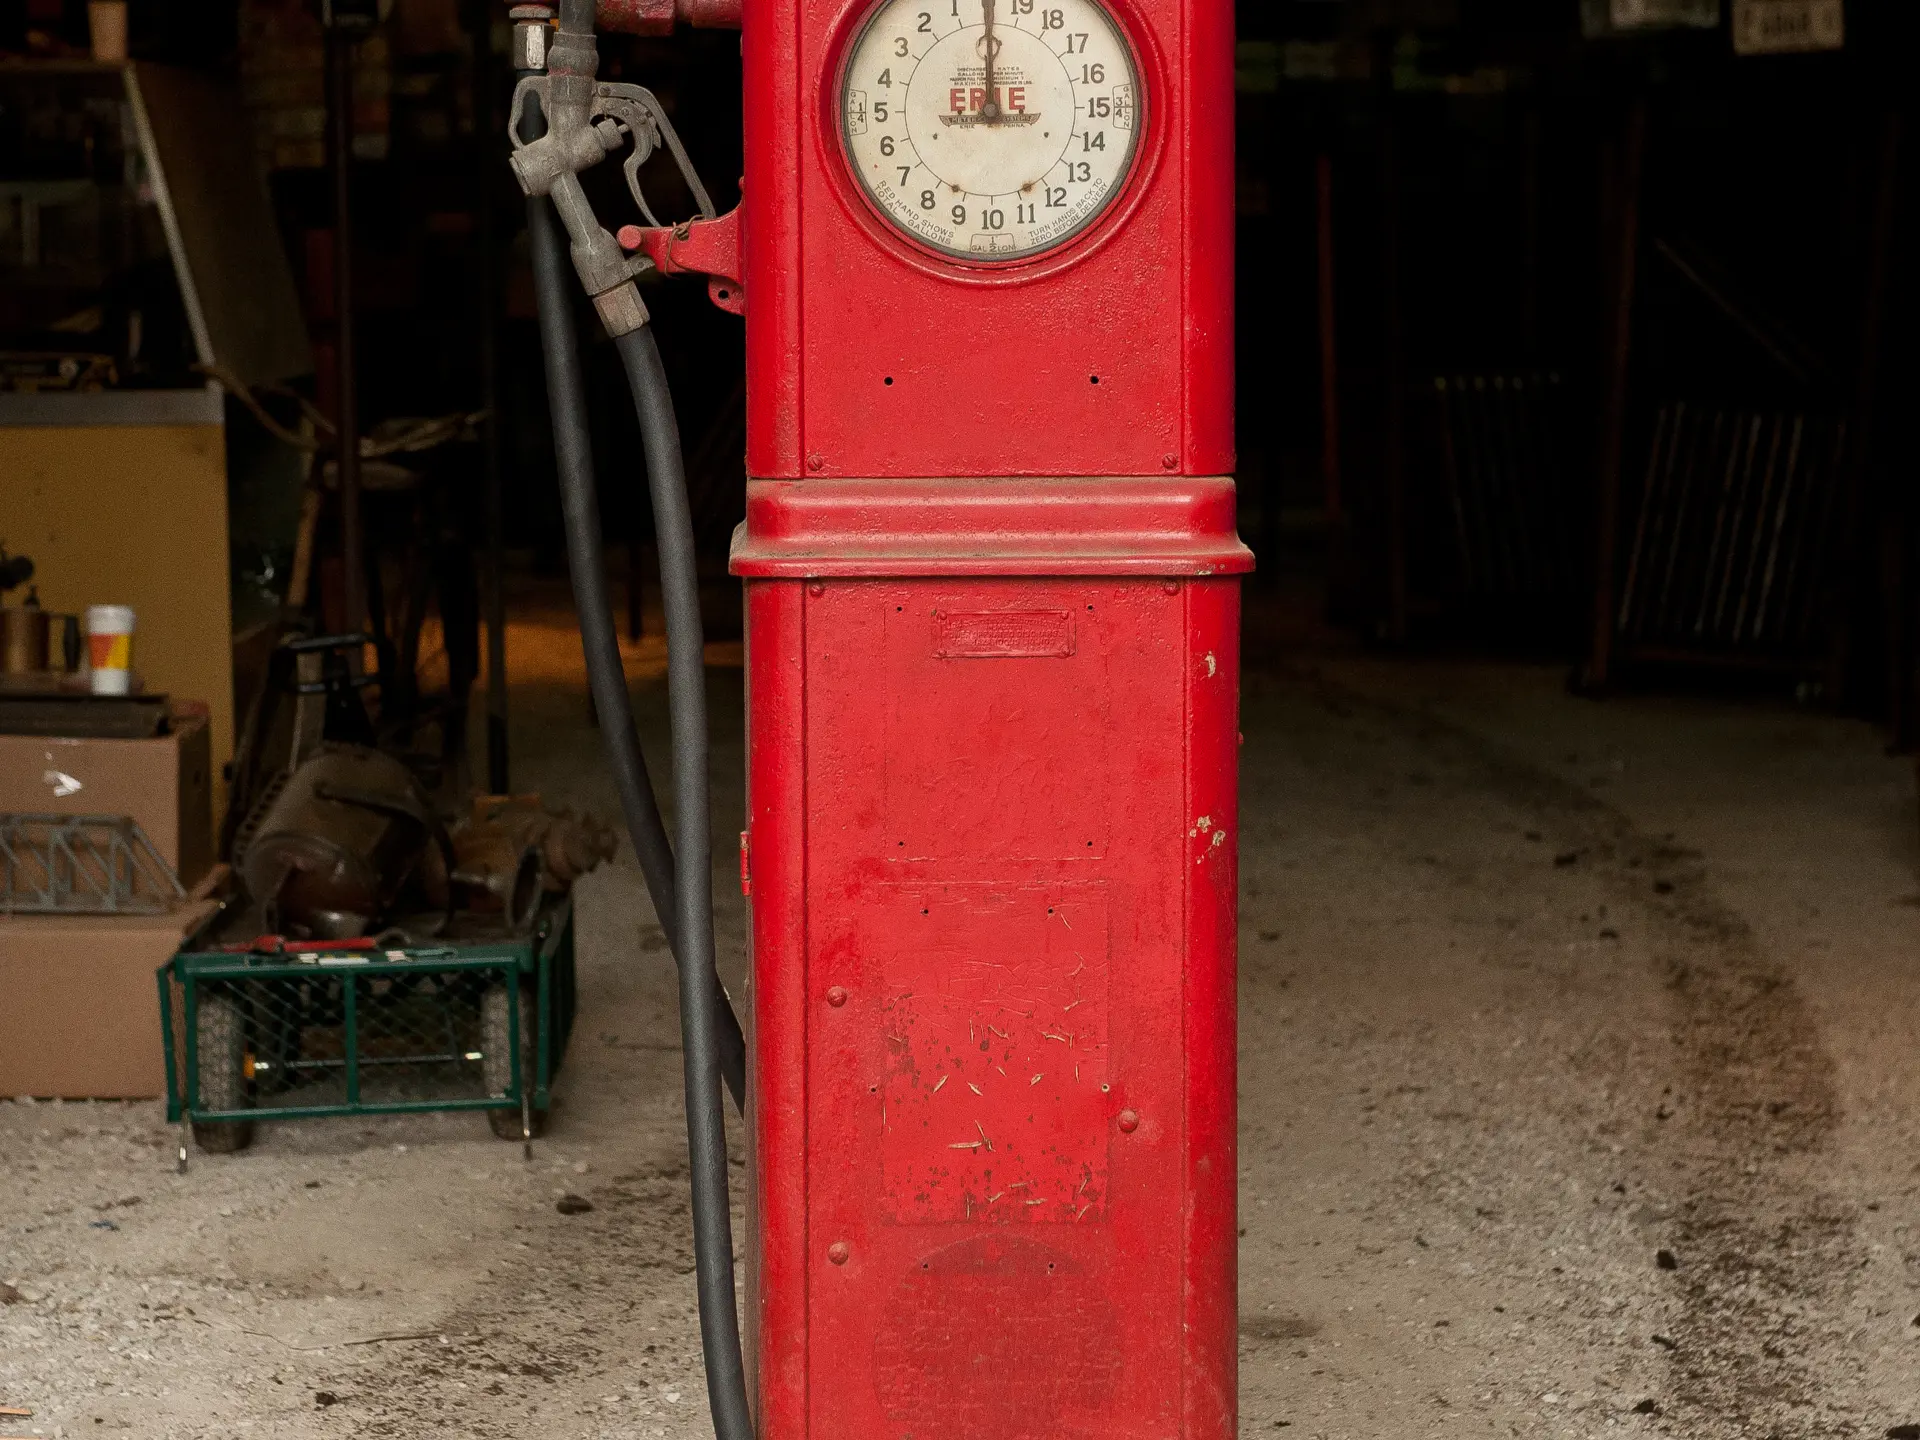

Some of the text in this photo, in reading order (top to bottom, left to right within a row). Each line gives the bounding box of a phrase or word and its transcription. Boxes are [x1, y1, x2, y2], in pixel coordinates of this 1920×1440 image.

[951, 0, 959, 16] 1
[1011, 0, 1033, 14] 19
[917, 12, 932, 32] 2
[1042, 9, 1064, 30] 18
[894, 37, 909, 57] 3
[1066, 33, 1089, 53] 17
[877, 68, 892, 88] 4
[1082, 63, 1105, 84] 16
[950, 87, 1025, 112] ERIE
[1088, 97, 1111, 118] 15
[874, 102, 889, 123] 5
[880, 135, 895, 157] 6
[1083, 131, 1105, 152] 14
[896, 166, 911, 186] 7
[1068, 162, 1091, 182] 13
[920, 190, 936, 210] 8
[1028, 177, 1103, 238] TURN HANDS BACK TO
[1045, 187, 1067, 208] 12
[874, 184, 952, 245] TOTAL GALLONS
[879, 180, 954, 239] RED HAND SHOWS
[951, 205, 966, 225] 9
[981, 209, 1004, 230] 10
[1017, 203, 1036, 224] 11
[1030, 182, 1108, 246] ZERO BEFORE DELIVERY
